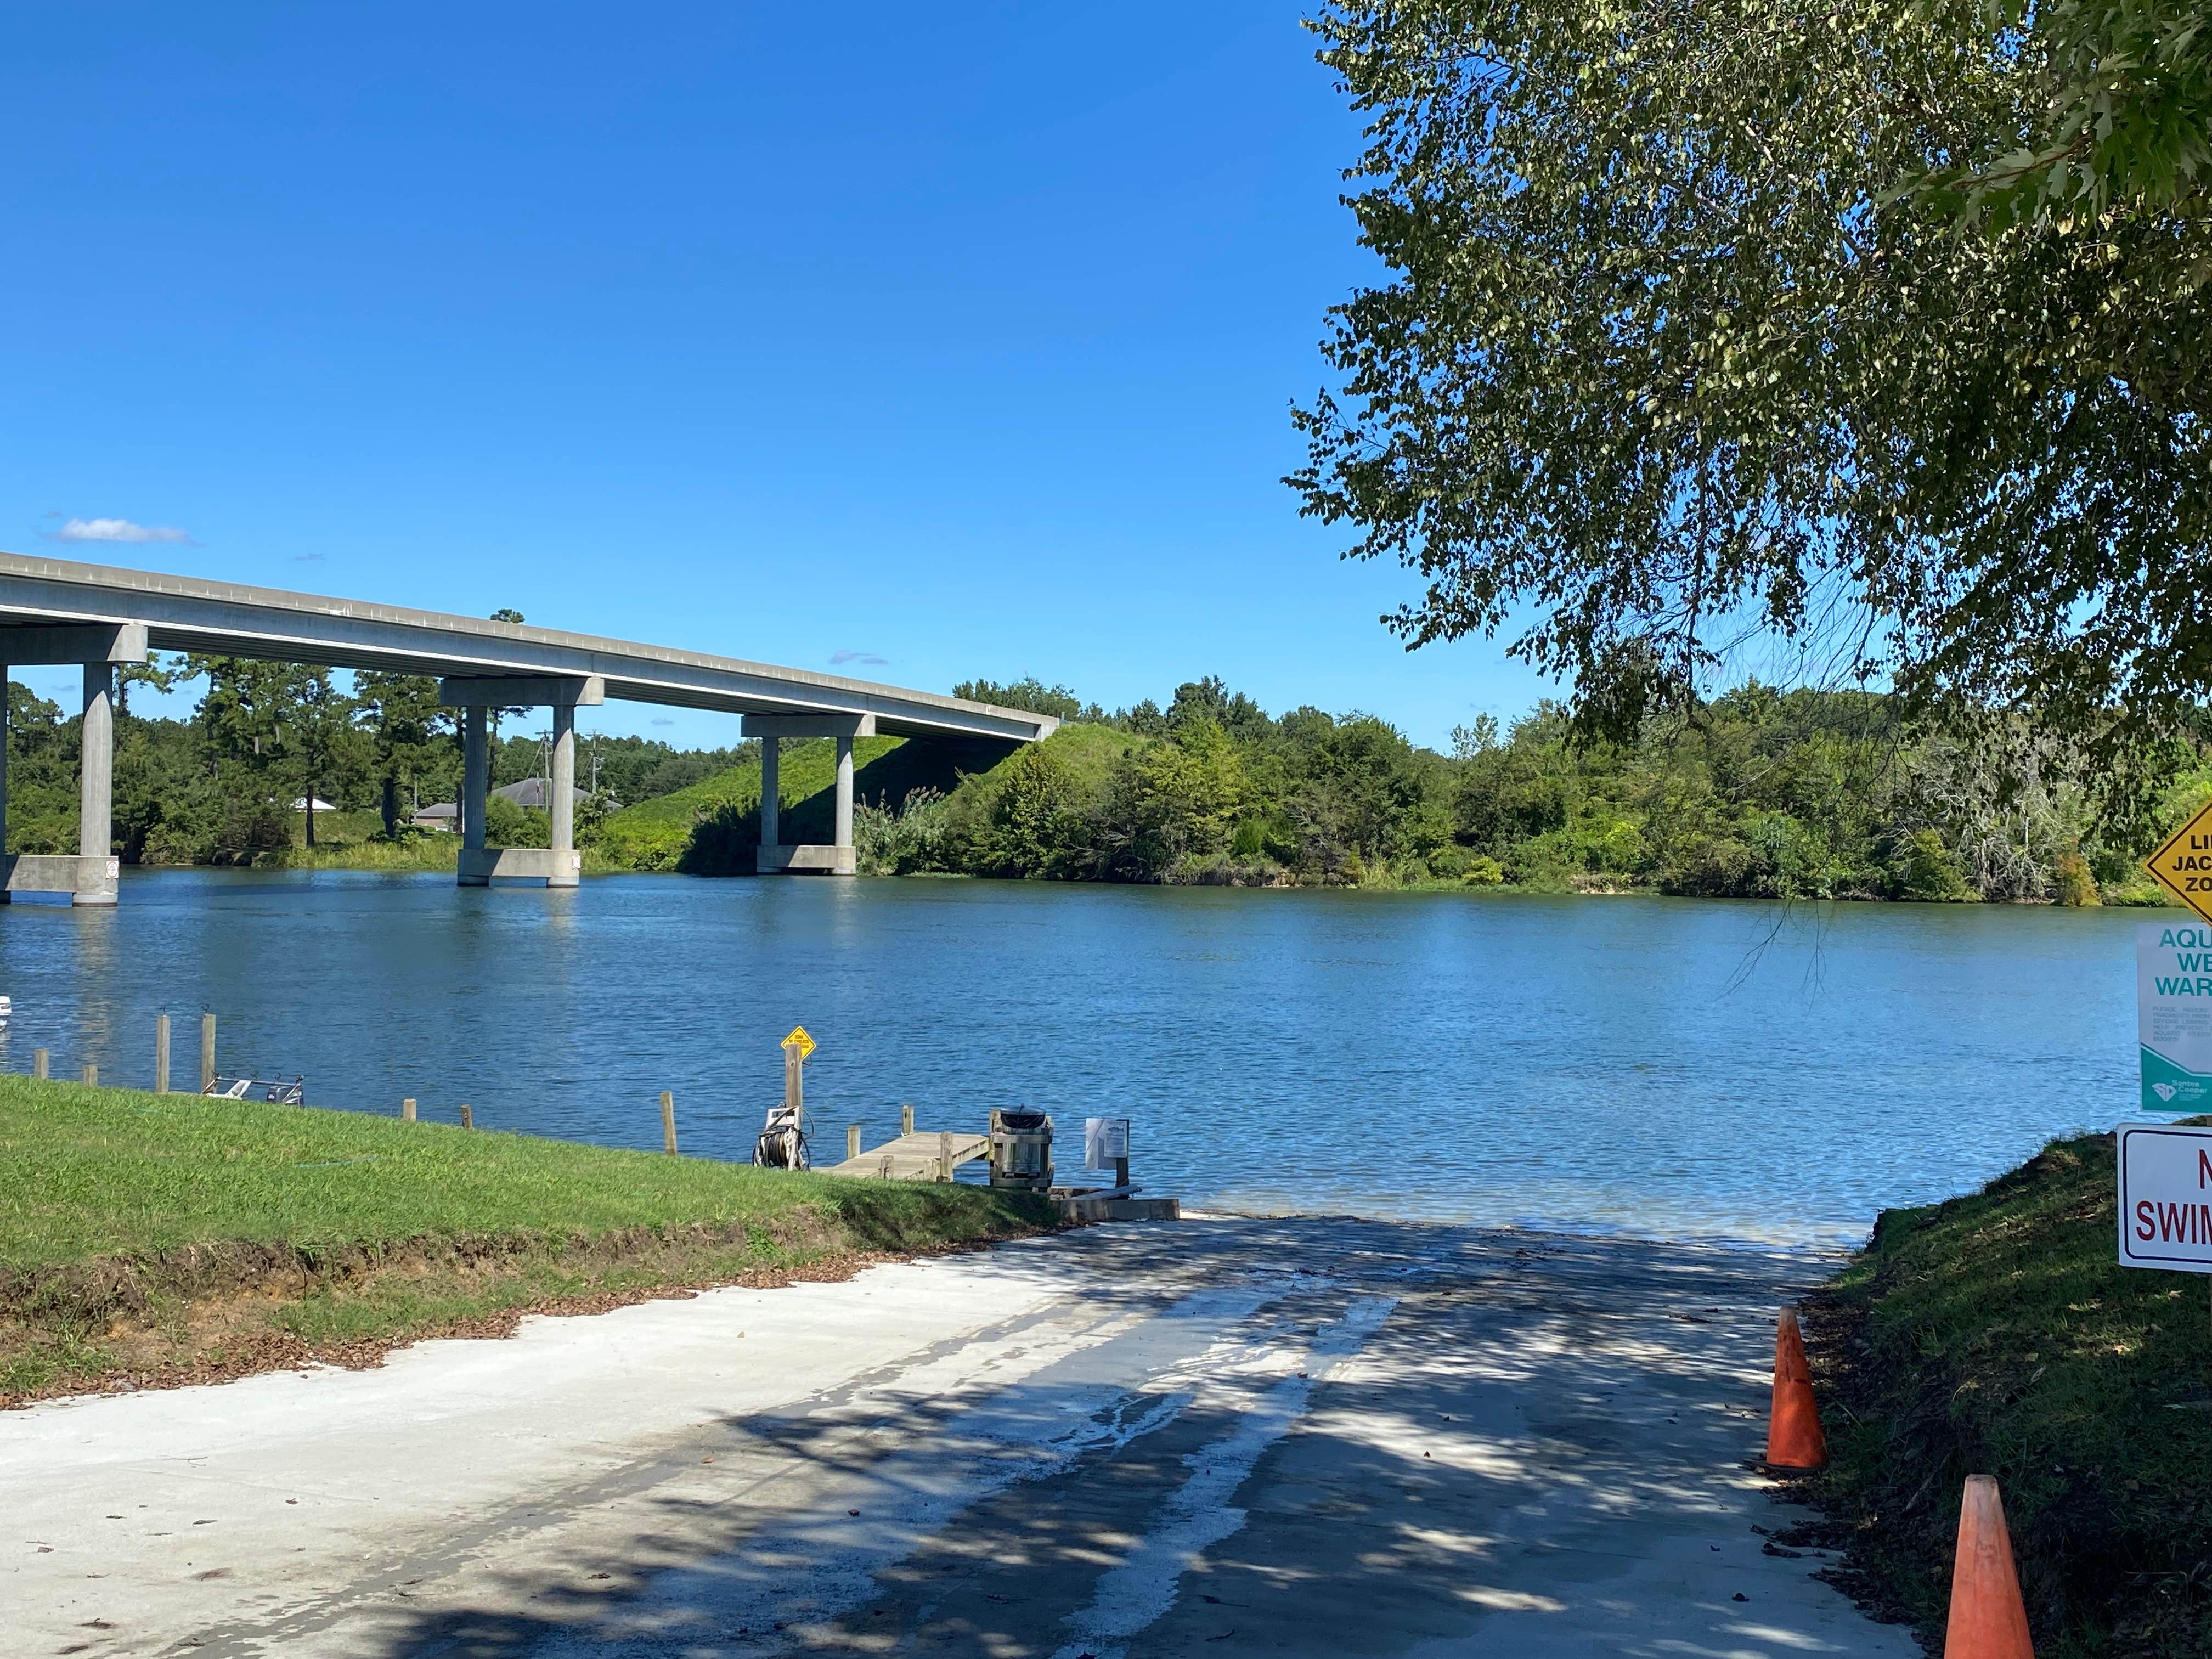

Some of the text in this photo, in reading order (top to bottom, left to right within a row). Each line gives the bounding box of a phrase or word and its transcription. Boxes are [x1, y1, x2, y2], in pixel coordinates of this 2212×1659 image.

[2191, 834, 2212, 849] LI
[2172, 856, 2212, 871] JAC
[2185, 877, 2212, 892] ZO
[2159, 929, 2212, 948] AQU
[2177, 953, 2212, 972] WE
[2154, 977, 2212, 996] WAR
